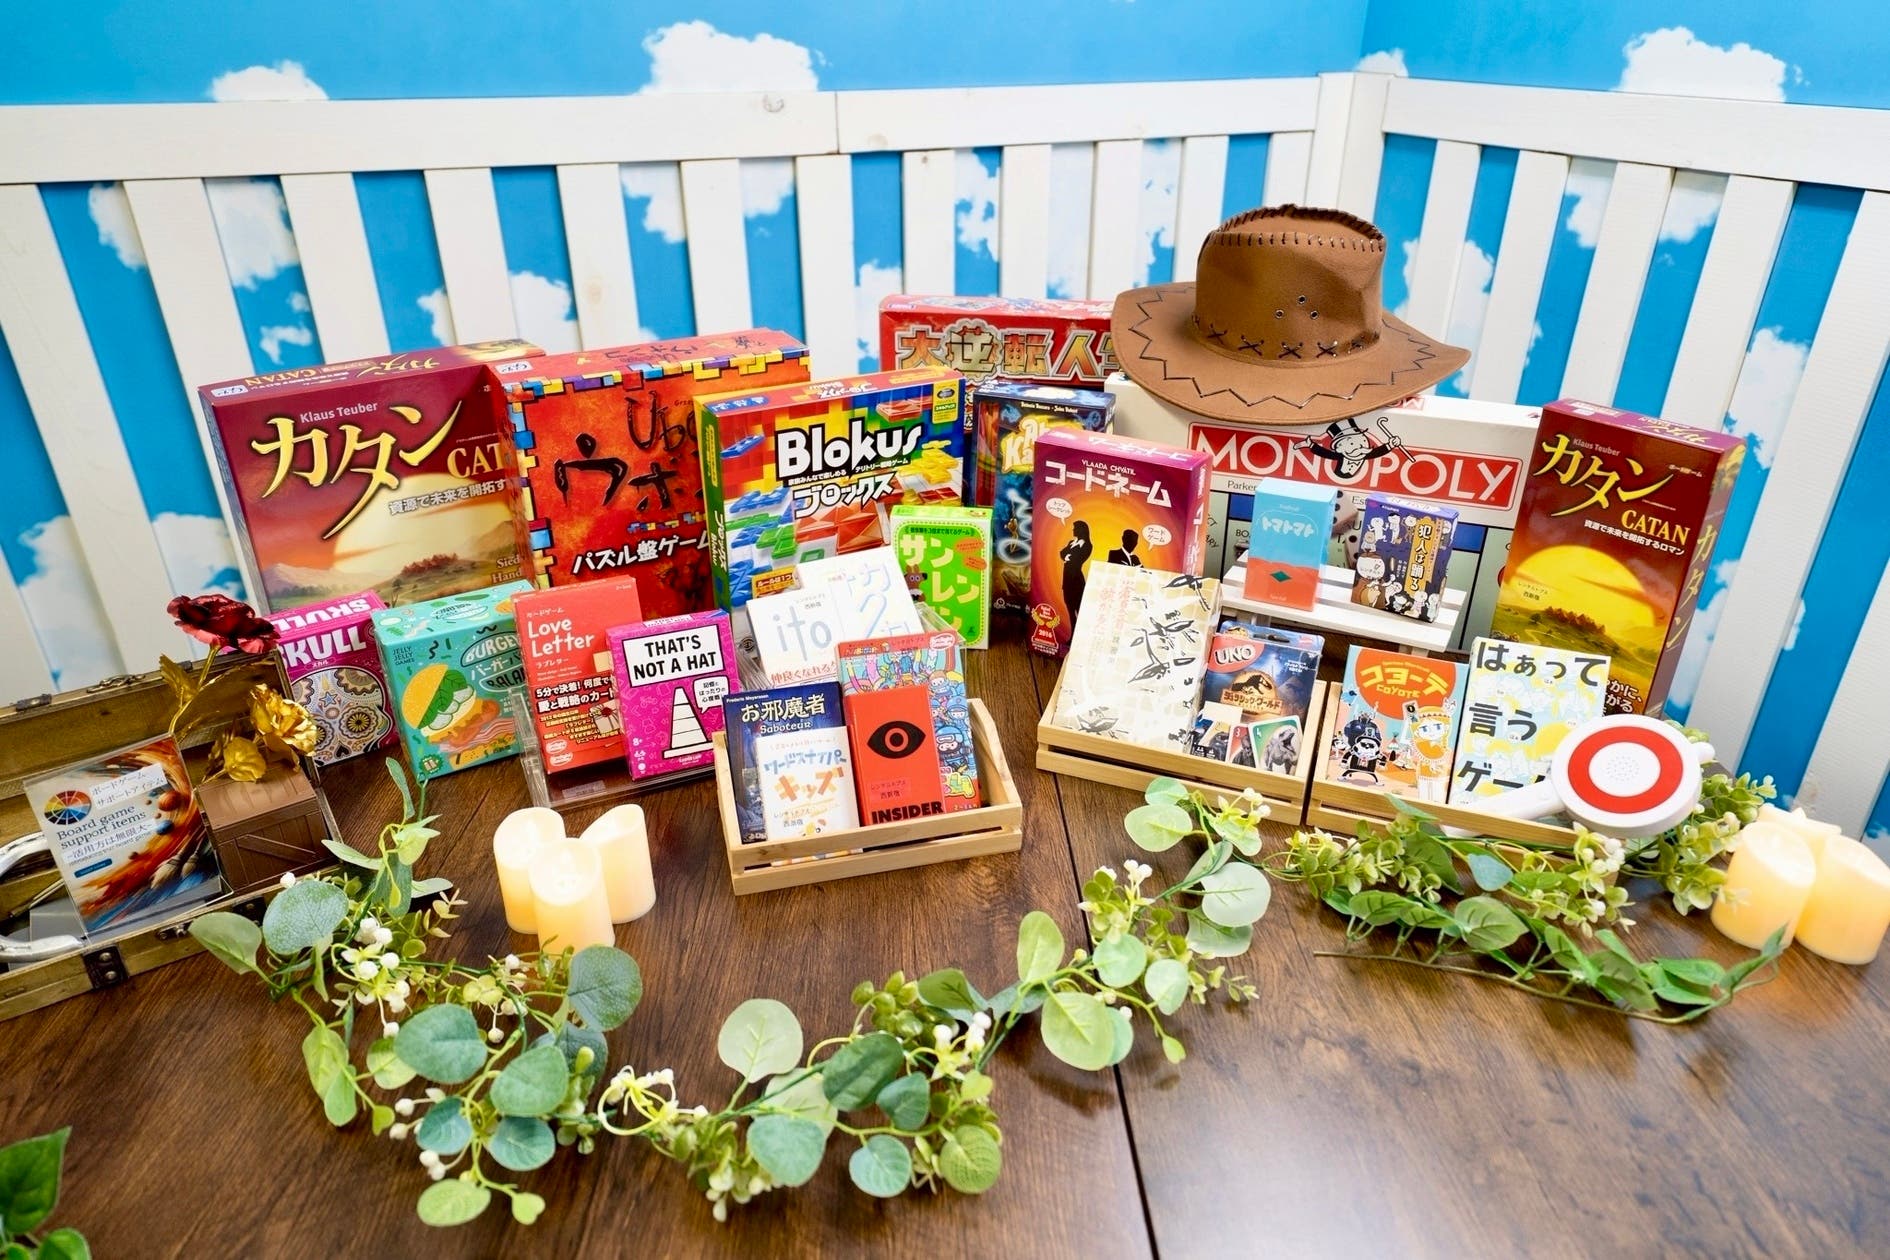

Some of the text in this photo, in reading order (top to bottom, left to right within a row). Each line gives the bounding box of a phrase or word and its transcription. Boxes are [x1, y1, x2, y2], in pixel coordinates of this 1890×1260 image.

[300, 401, 378, 424] Klaus Teuber
[778, 420, 922, 478] Blokus
[1572, 437, 1620, 456] Klaus Teuber
[251, 401, 462, 540] カタン
[1082, 459, 1108, 470] VLAADA
[1196, 429, 1514, 501] MONOPOLY
[1532, 434, 1674, 517] カタン
[794, 471, 897, 519] ブロックス
[1045, 460, 1172, 508] コードネーム
[1262, 516, 1315, 539] トマトマト
[1621, 509, 1691, 546] CATAN
[900, 534, 954, 568] サン
[1410, 524, 1432, 591] 犯人は踊る
[932, 571, 979, 604] レン
[1666, 524, 1718, 650] カタン
[270, 598, 372, 632] SKULL
[527, 618, 572, 639] Love
[531, 632, 595, 658] Letter
[645, 635, 701, 657] THAT'S
[772, 605, 832, 661] ito
[536, 658, 569, 668] ラブレター
[633, 651, 717, 680] NOT A HAT
[1215, 644, 1256, 664] UNO
[1360, 665, 1448, 696] コヨーテ
[741, 693, 825, 722] お邪魔者
[1469, 702, 1537, 741] 言う
[92, 773, 146, 796] ボードゲーム
[774, 766, 845, 802] キッズ
[57, 806, 135, 840] Board game
[871, 800, 944, 825] INSIDER
[60, 825, 110, 850] support
[112, 812, 147, 830] items
